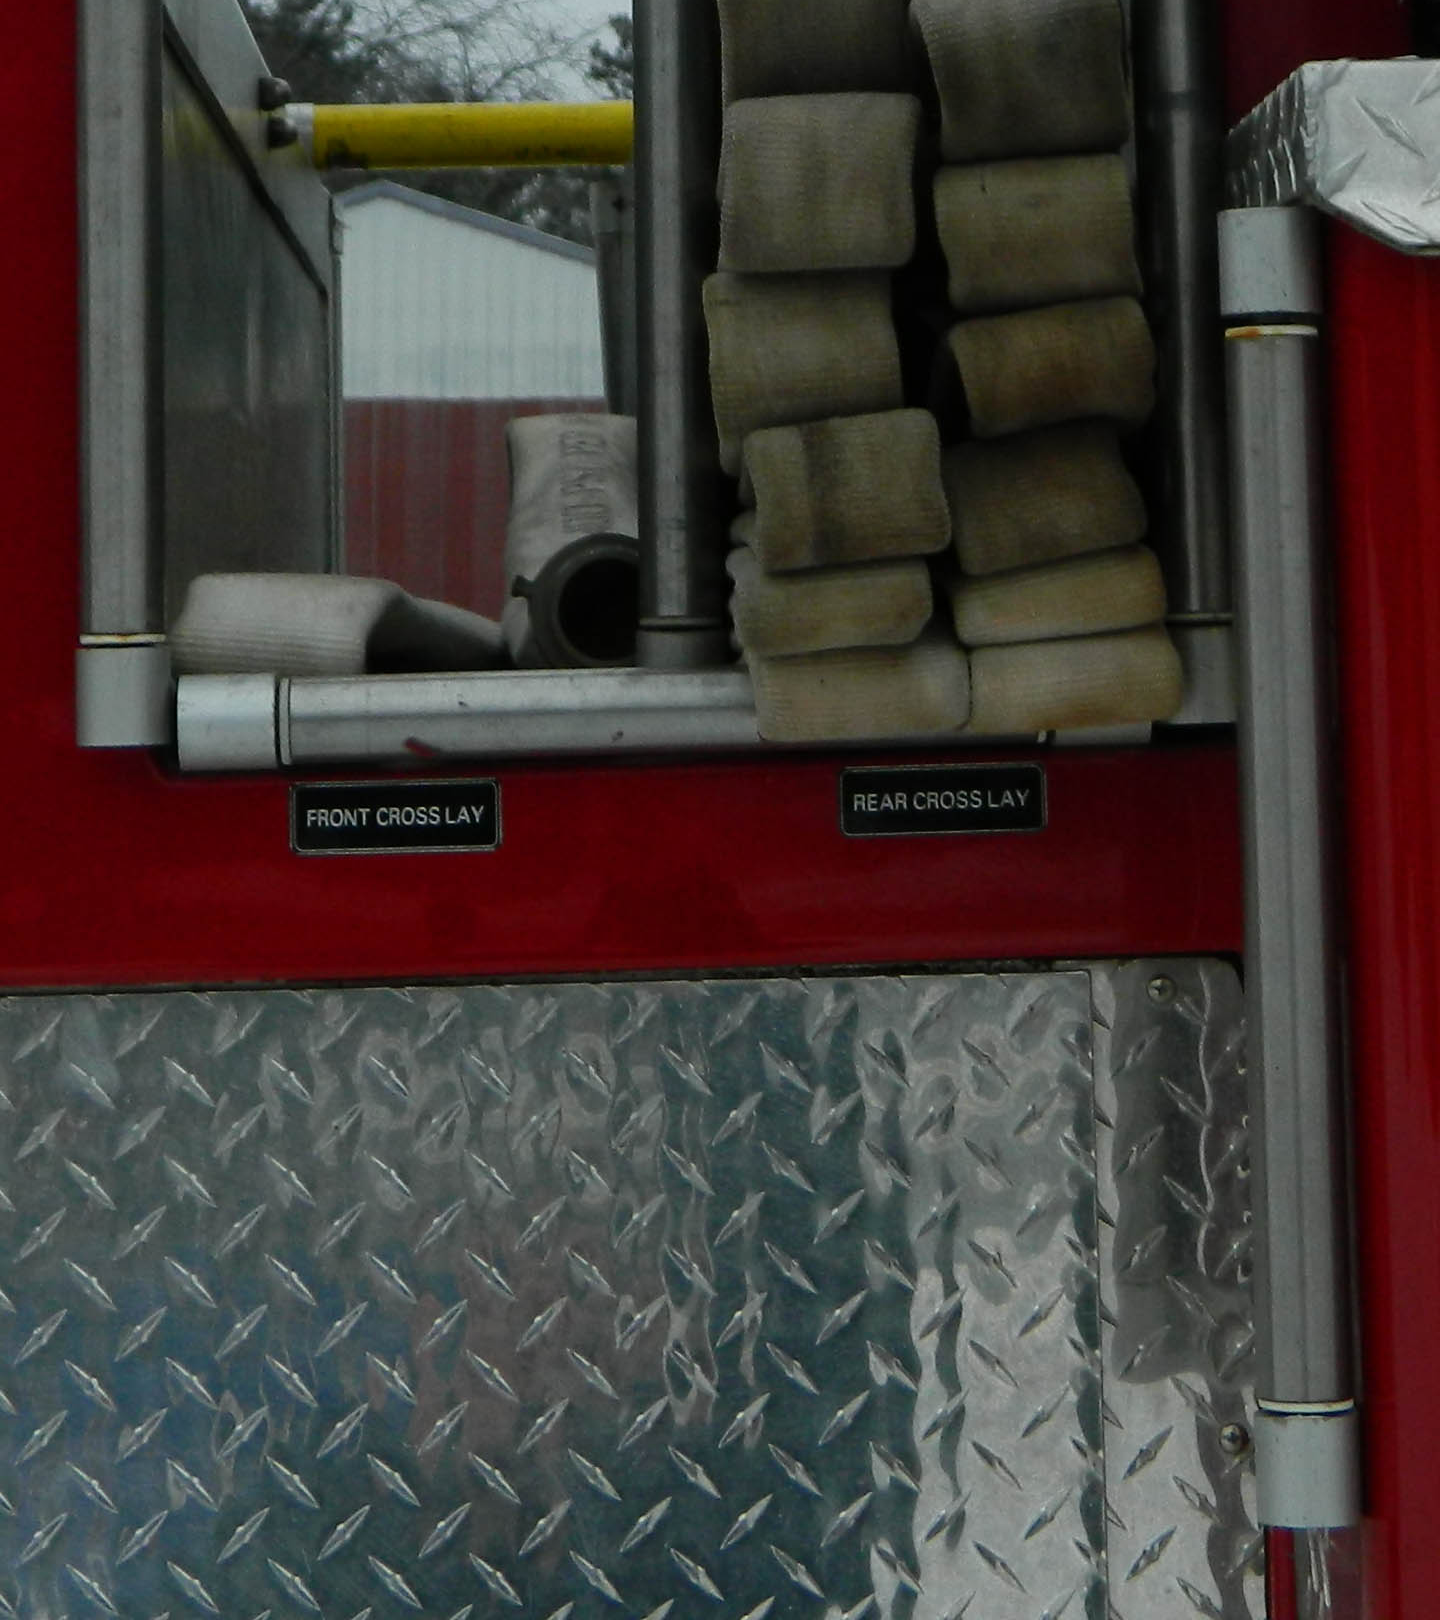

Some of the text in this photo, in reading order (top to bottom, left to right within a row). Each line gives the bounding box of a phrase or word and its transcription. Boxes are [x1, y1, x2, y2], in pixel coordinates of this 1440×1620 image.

[853, 788, 1030, 812] REAR CROSS LAY
[306, 804, 485, 827] FRONT CROSS LAY
